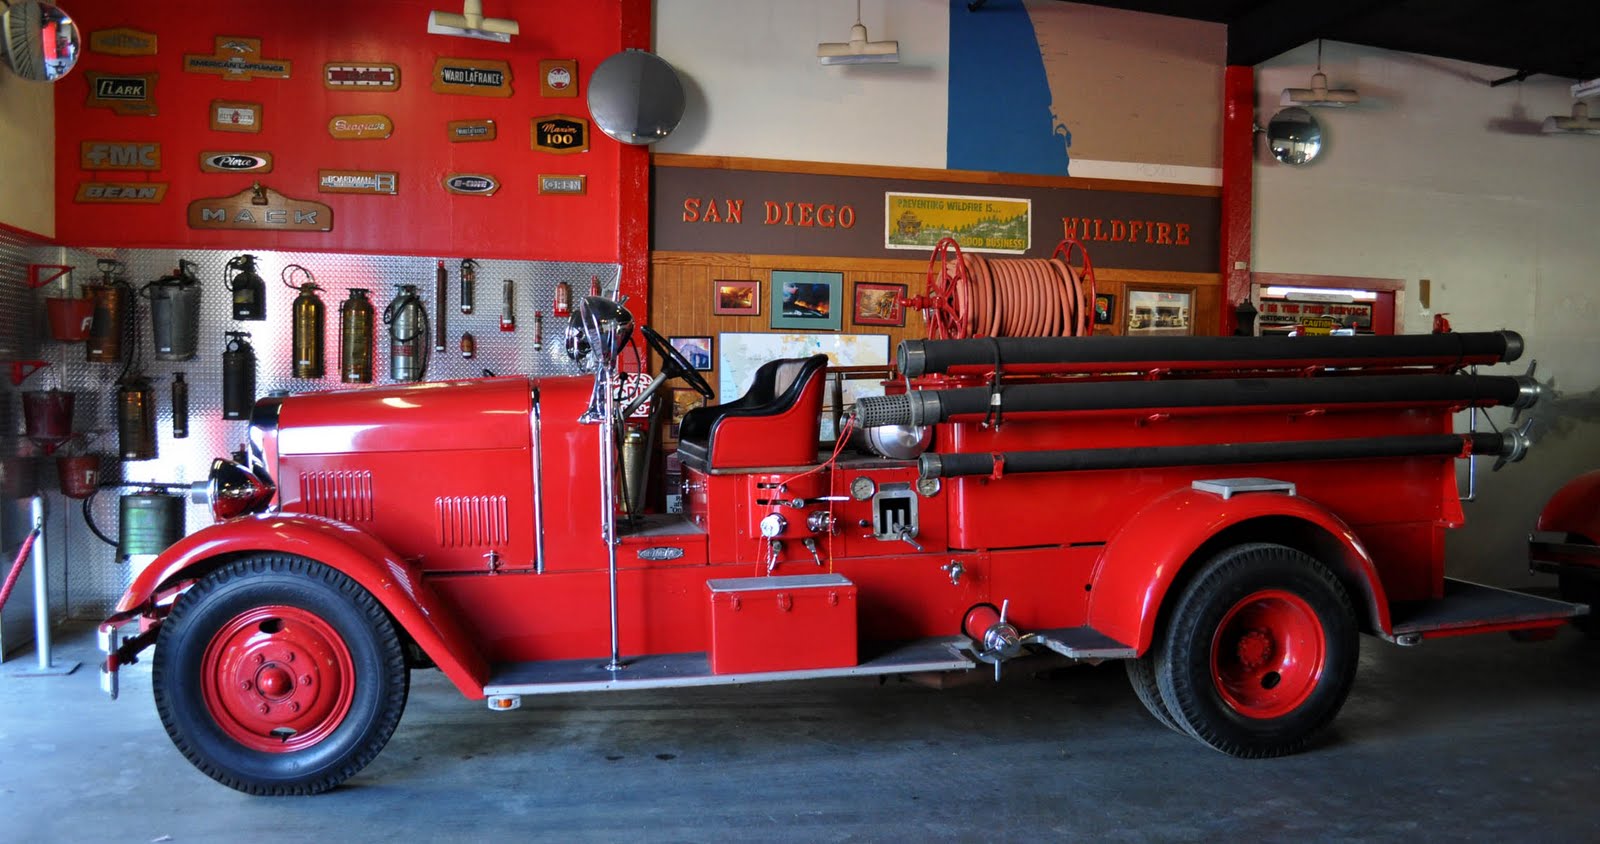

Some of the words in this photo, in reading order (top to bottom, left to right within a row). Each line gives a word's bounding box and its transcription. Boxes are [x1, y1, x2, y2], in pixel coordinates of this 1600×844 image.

[444, 69, 464, 82] WARD
[99, 80, 143, 96] CLARK
[541, 123, 577, 133] Maxim
[547, 134, 573, 145] 100
[87, 145, 155, 166] FMC
[219, 156, 252, 167] Pierce
[86, 187, 156, 198] BEAN
[897, 199, 945, 211] PREVENTING
[946, 201, 983, 212] WILDFIRE
[202, 208, 318, 224] MACK
[682, 198, 743, 224] SAN
[764, 201, 856, 228] DIEGO
[1062, 217, 1190, 245] WILDFIRE
[961, 236, 983, 247] GOOD
